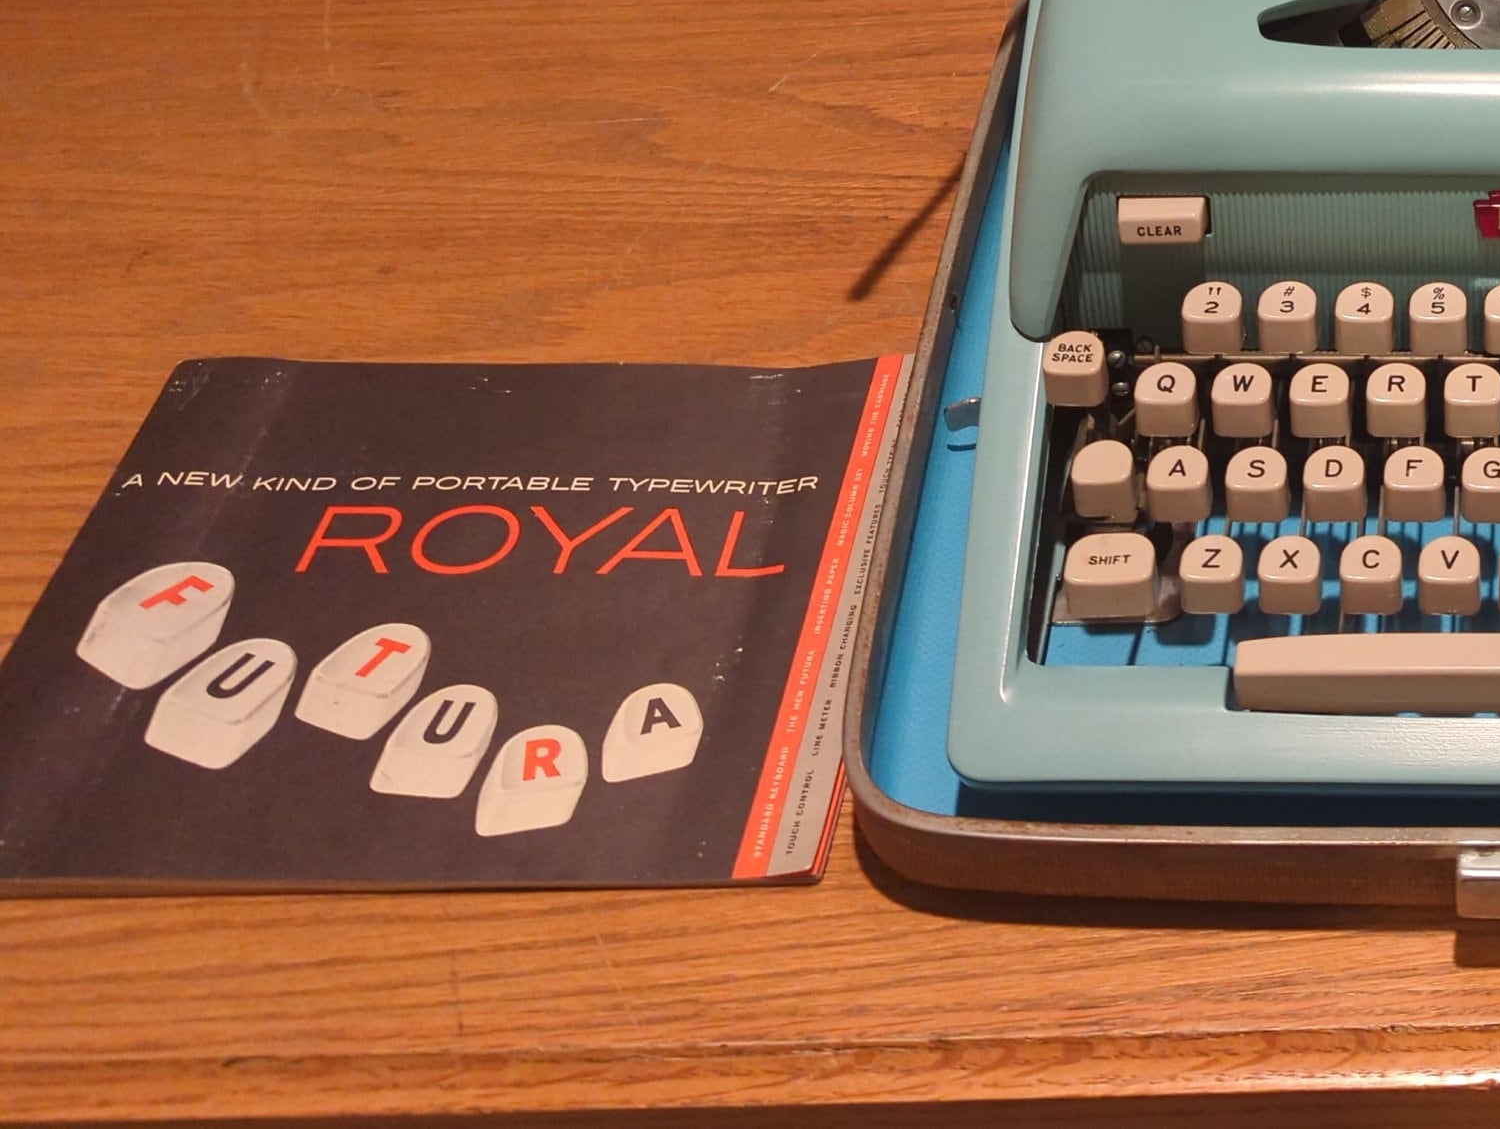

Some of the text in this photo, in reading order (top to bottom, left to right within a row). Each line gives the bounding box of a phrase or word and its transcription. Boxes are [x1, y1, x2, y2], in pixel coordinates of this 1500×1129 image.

[1136, 224, 1183, 237] CLEAR
[1202, 300, 1220, 314] 2
[1278, 300, 1296, 314] 3
[1356, 301, 1372, 316] 4
[1430, 301, 1446, 316] 5
[1051, 351, 1094, 364] SPACE
[1057, 342, 1093, 355] BACK
[1156, 374, 1176, 394] Q
[1232, 374, 1255, 394] W
[1311, 375, 1329, 393] E
[1387, 375, 1406, 393] R
[1465, 375, 1483, 393] T
[1168, 459, 1188, 478] A
[1246, 460, 1266, 479] S
[1324, 460, 1344, 478] D
[1404, 460, 1423, 478] F
[121, 470, 820, 496] A NEW KIND OF PORTABLE TYPEWRITER
[294, 504, 788, 578] ROYAL
[1088, 553, 1131, 566] SHIFT
[1202, 550, 1222, 569] Z
[1279, 550, 1300, 570] X
[1362, 550, 1380, 570] C
[1440, 550, 1460, 570] V
[786, 699, 832, 856] TOUCH CONTROL LINE METER
[753, 746, 789, 858] STANDARD KEYBOARD
